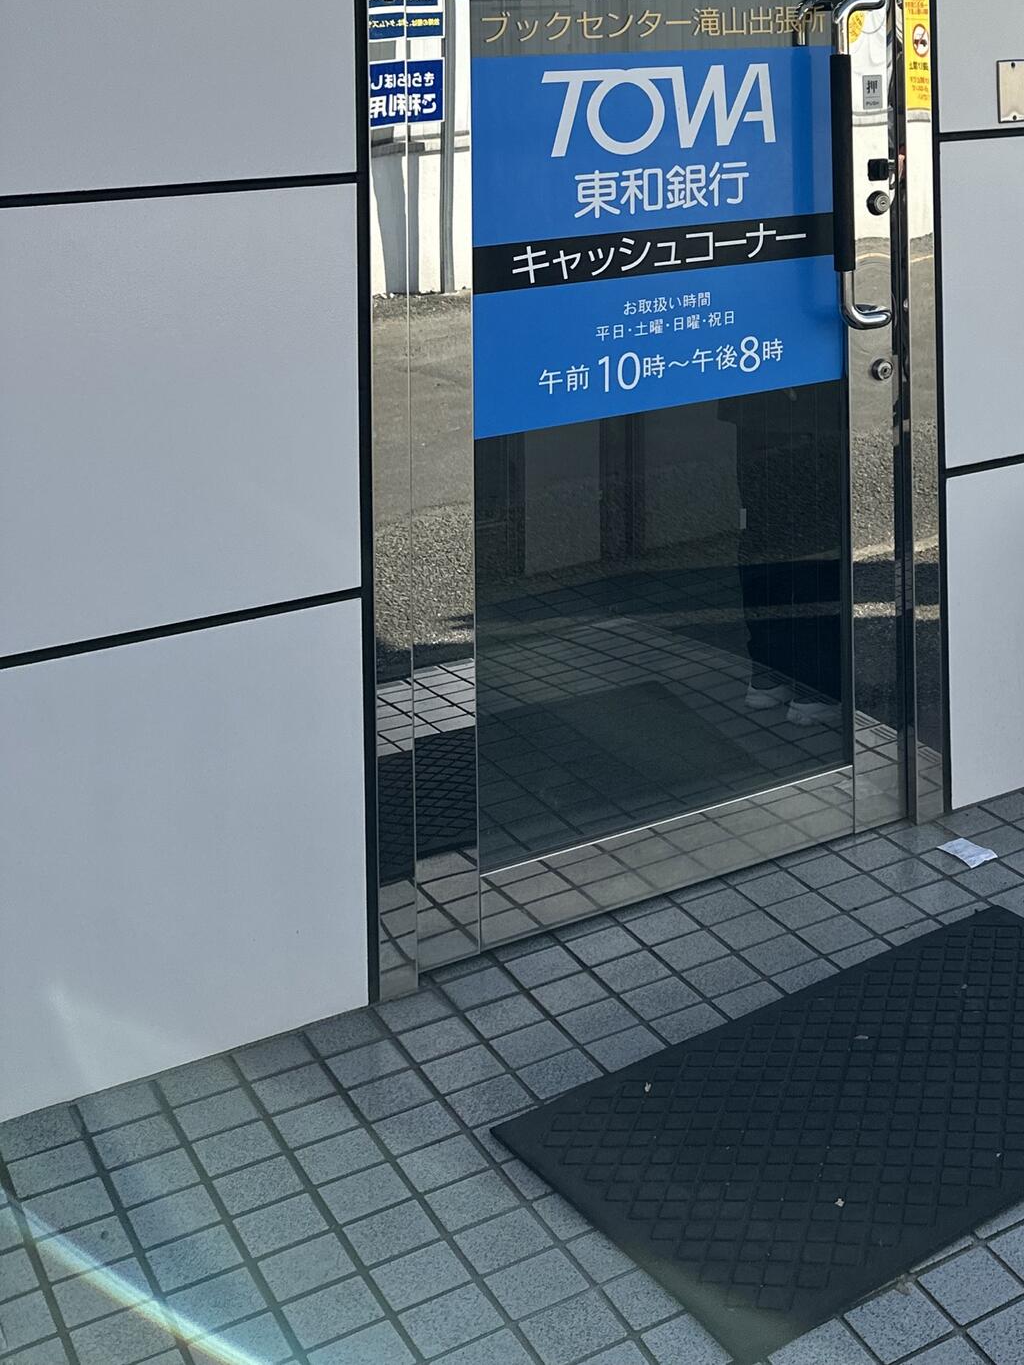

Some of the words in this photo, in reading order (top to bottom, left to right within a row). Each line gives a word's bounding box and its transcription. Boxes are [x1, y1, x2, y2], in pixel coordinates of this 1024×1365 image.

[481, 7, 826, 45] ブックセンター滝山出張所
[866, 80, 879, 94] 押
[540, 62, 777, 159] TOWA
[574, 161, 750, 219] 東和銀行
[511, 222, 807, 285] キャッシュコーナー
[623, 290, 712, 317] お取扱い時間
[595, 311, 736, 341] 平日・土曜・日曜・祝日
